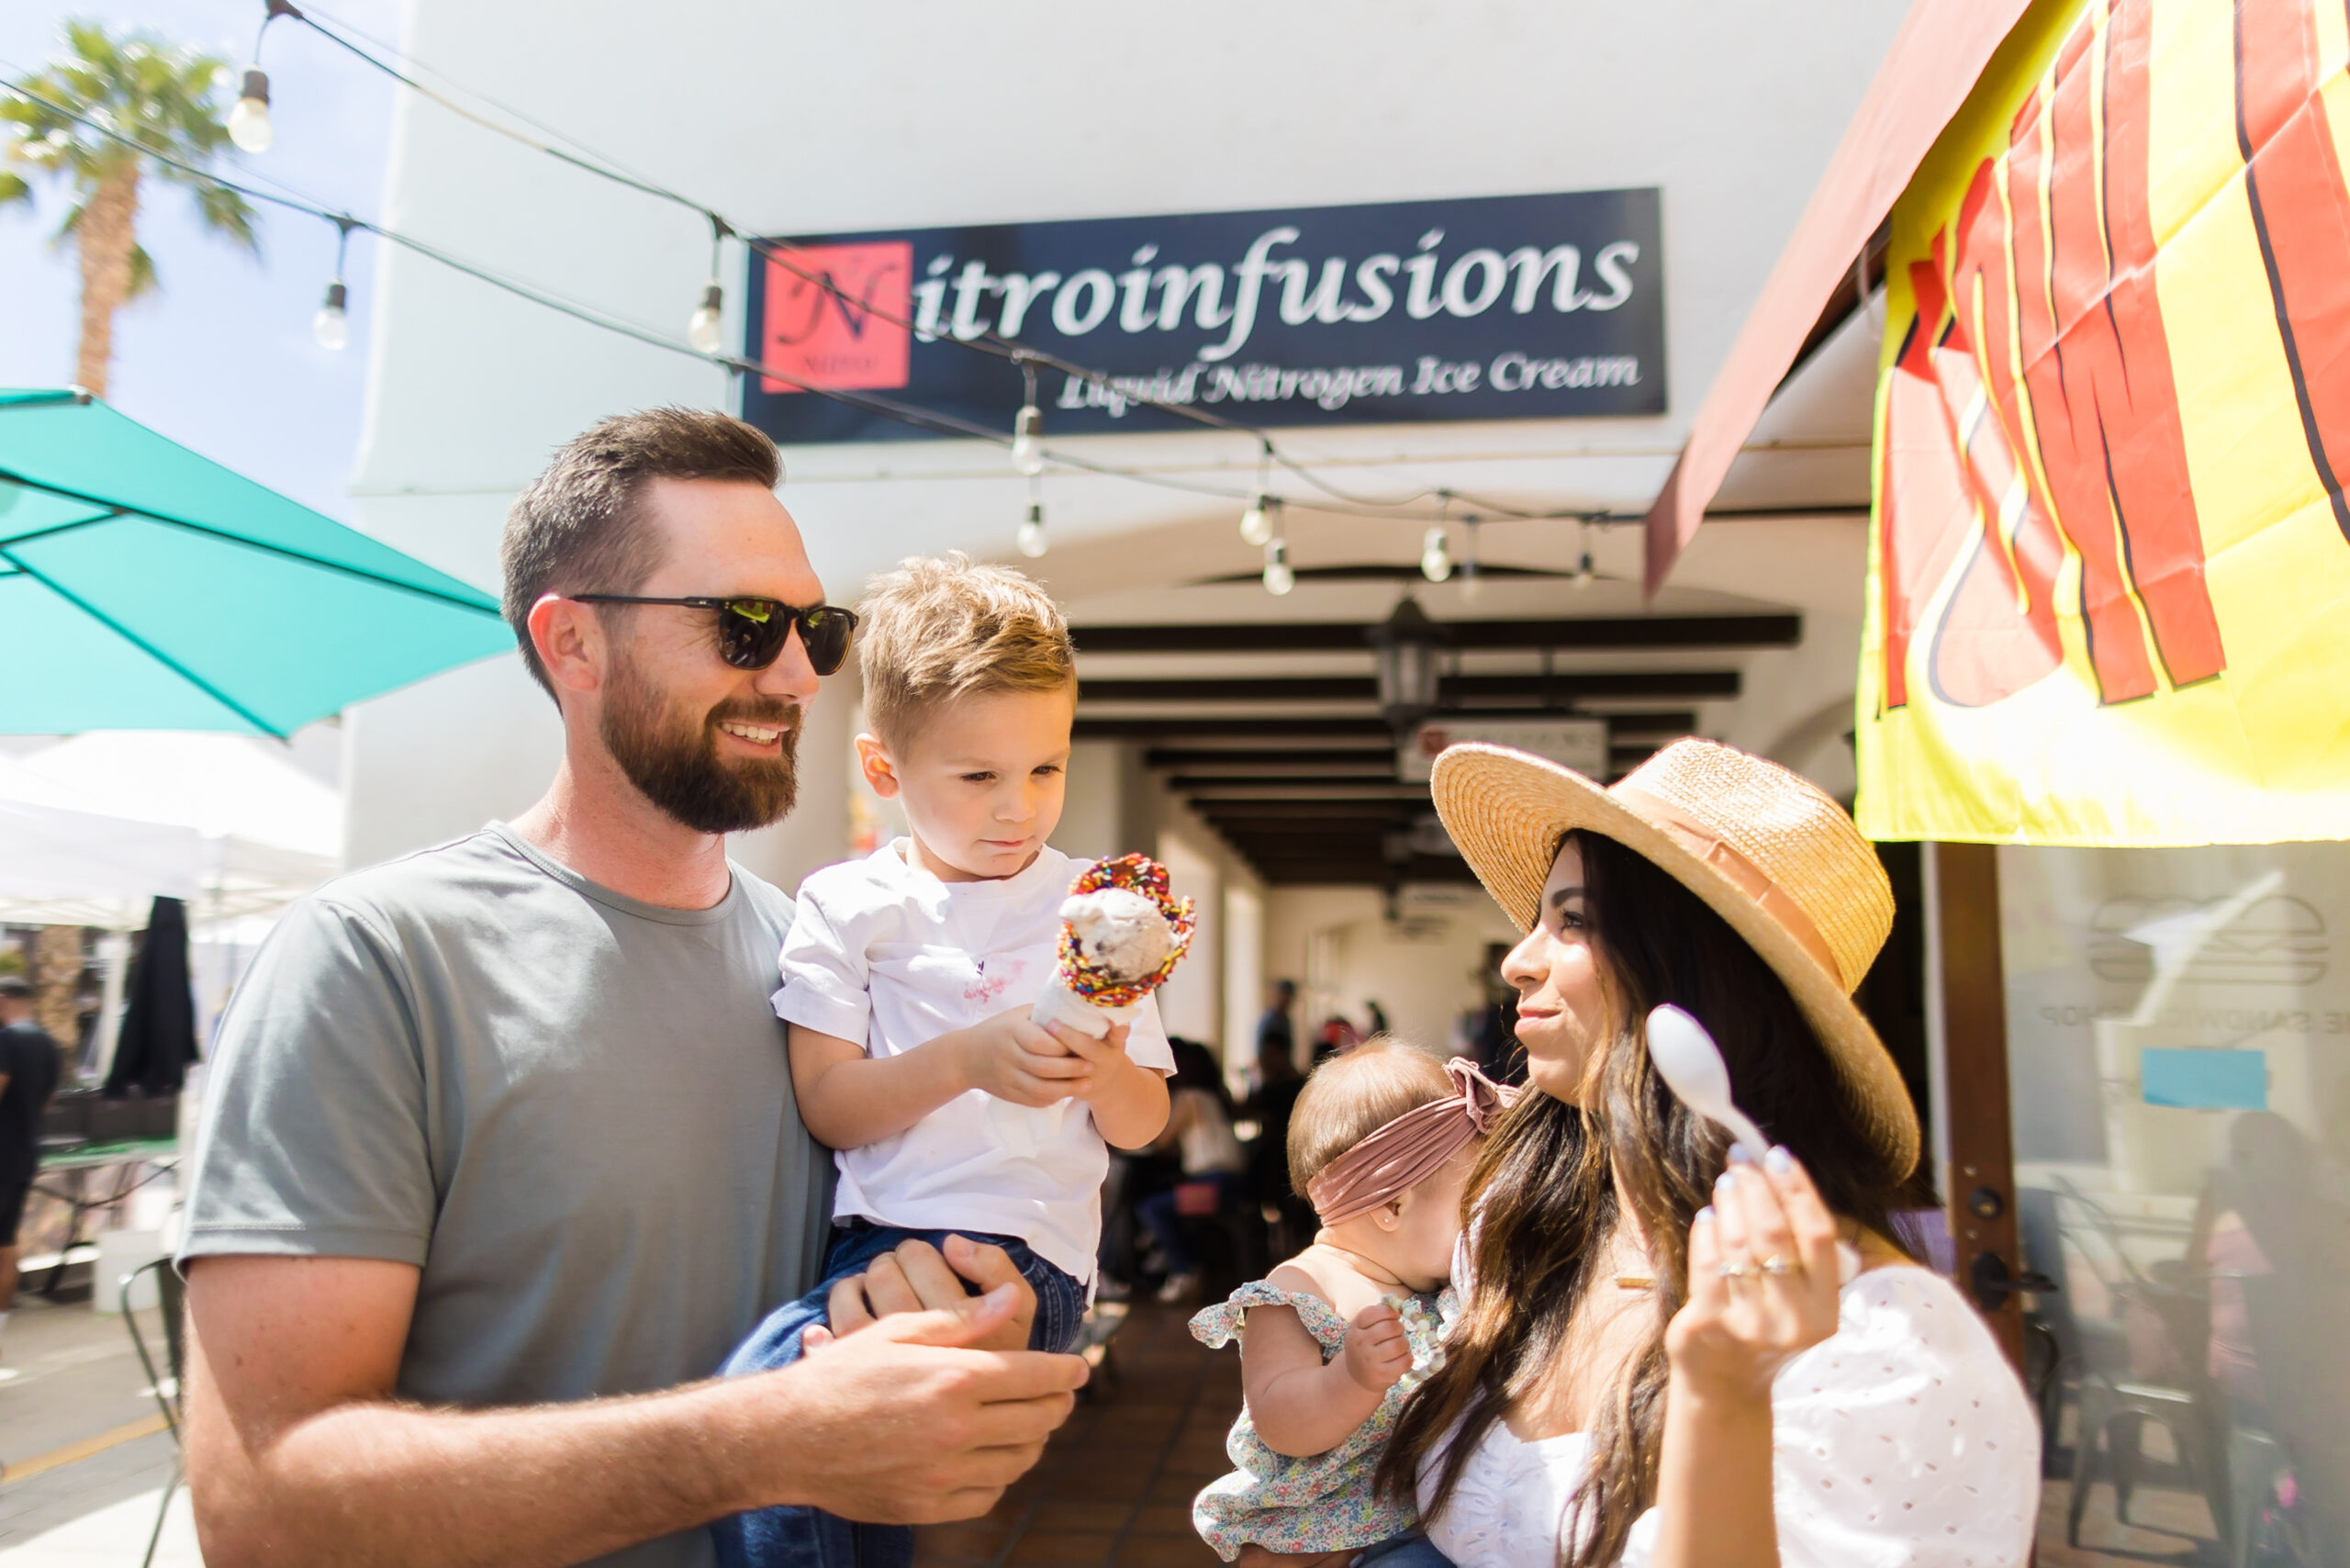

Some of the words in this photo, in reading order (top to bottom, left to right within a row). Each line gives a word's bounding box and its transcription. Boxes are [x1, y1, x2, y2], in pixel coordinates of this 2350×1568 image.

[1058, 363, 1204, 418] Liquid
[1203, 359, 1407, 410] Nitrogen
[1410, 355, 1481, 395] Ice
[1489, 353, 1640, 392] Cream
